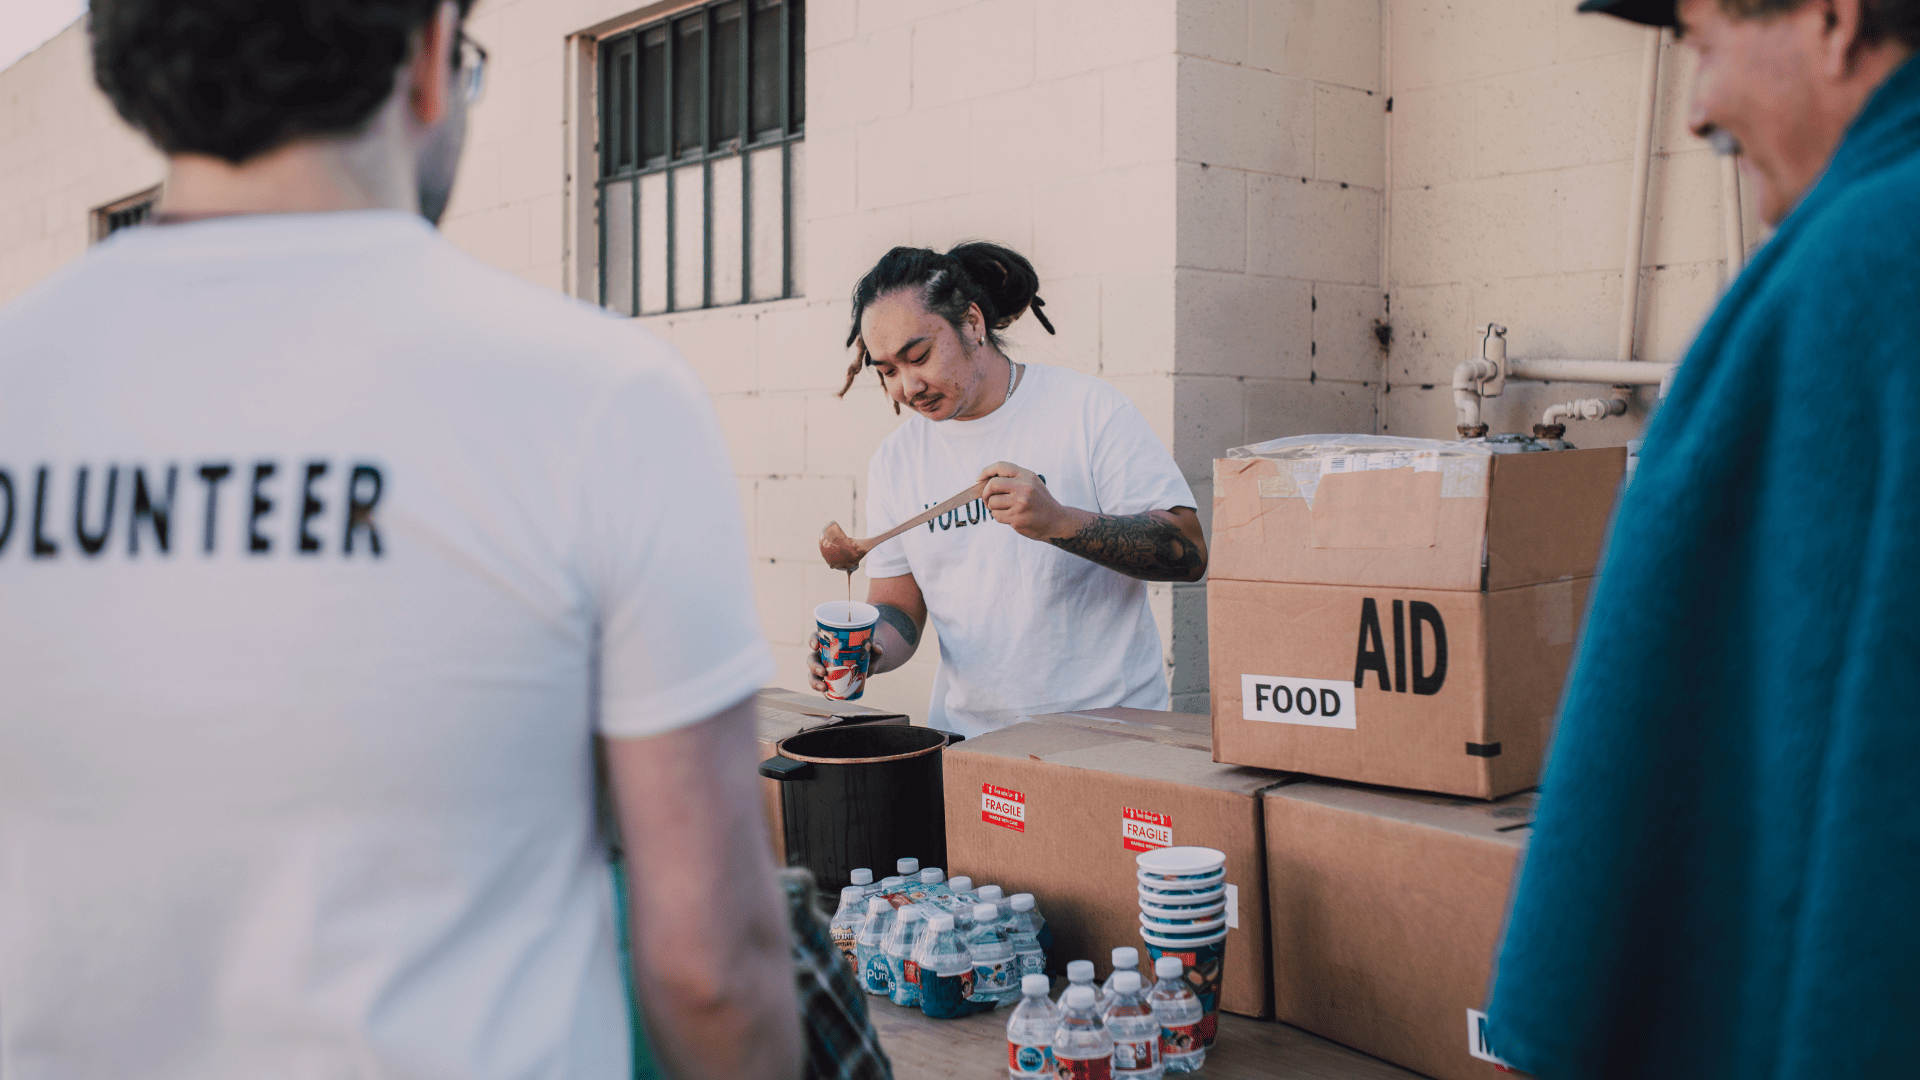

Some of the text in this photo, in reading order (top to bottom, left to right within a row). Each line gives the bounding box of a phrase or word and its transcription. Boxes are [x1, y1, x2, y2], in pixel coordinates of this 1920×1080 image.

[1354, 598, 1448, 696] AID
[1255, 683, 1341, 717] FOOD
[985, 798, 1022, 818] FRAGILE
[1127, 823, 1169, 843] FRAGILE
